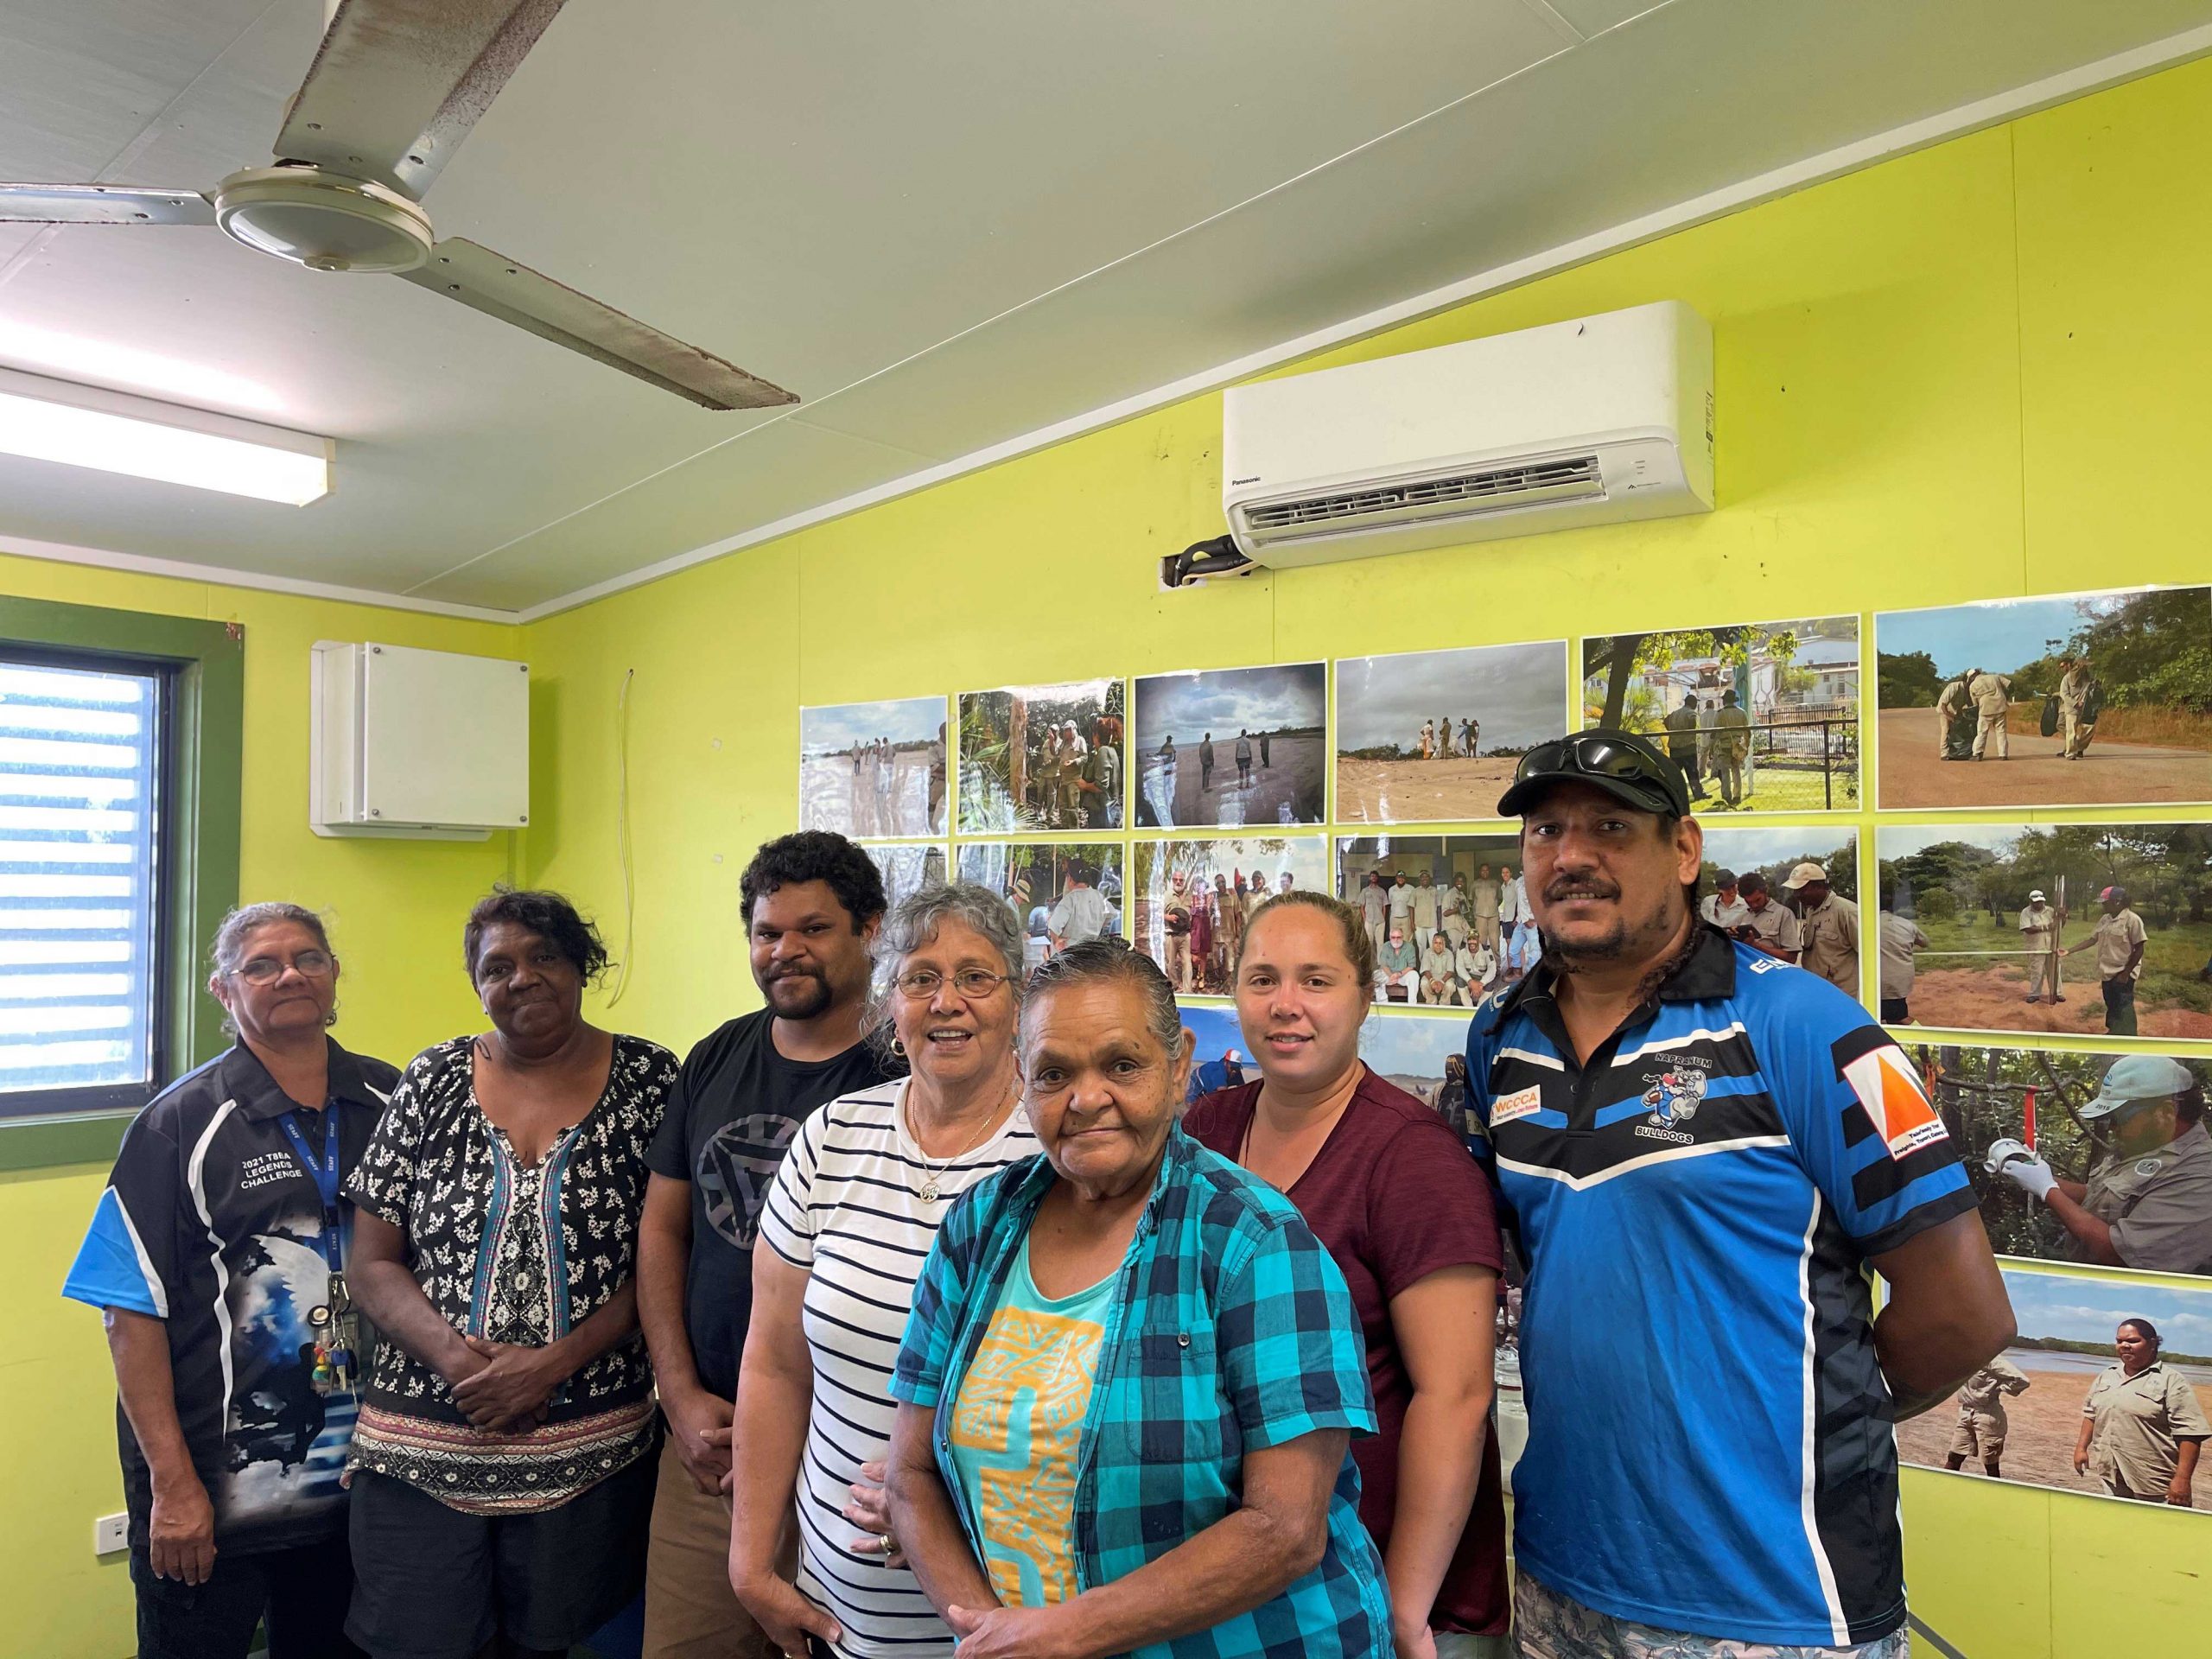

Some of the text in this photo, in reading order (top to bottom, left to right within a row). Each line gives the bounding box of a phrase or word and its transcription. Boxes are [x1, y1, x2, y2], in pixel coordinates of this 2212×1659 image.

[1231, 475, 1262, 486] Panasonic
[1654, 1052, 1713, 1069] NAPRANUM
[1496, 1091, 1537, 1113] WCCCA
[1635, 1125, 1694, 1145] BULLDOGS
[242, 1156, 264, 1169] 2021
[245, 1160, 293, 1179] LEGENDS
[240, 1169, 303, 1190] CHALLENGE
